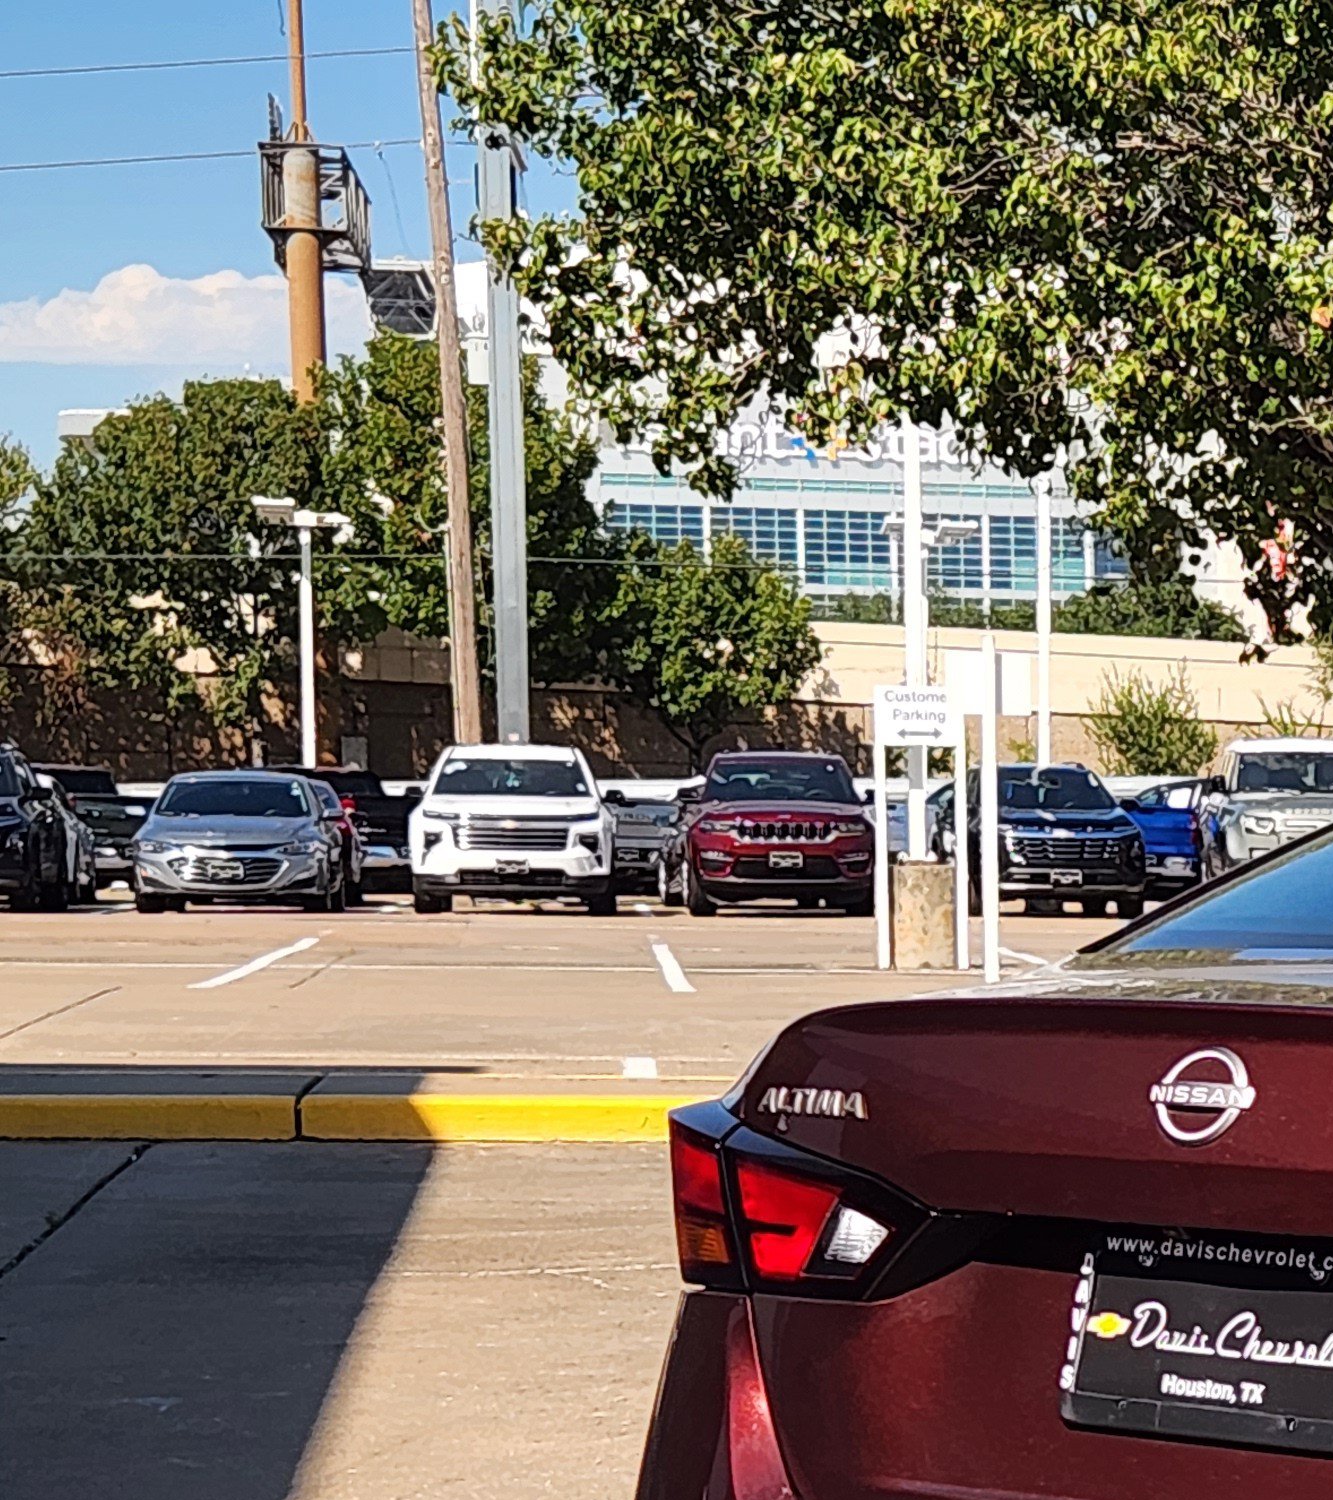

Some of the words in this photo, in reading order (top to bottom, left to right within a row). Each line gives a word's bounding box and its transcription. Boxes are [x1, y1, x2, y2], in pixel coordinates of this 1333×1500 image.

[884, 690, 947, 703] Custome
[893, 708, 946, 724] Parking
[757, 1086, 869, 1120] ALTIMA
[1149, 1084, 1255, 1109] NISSAN
[1059, 1252, 1094, 1390] DAVIS
[1130, 1300, 1215, 1356] Davis
[1160, 1373, 1237, 1405] Houston,
[1239, 1381, 1267, 1405] TX
